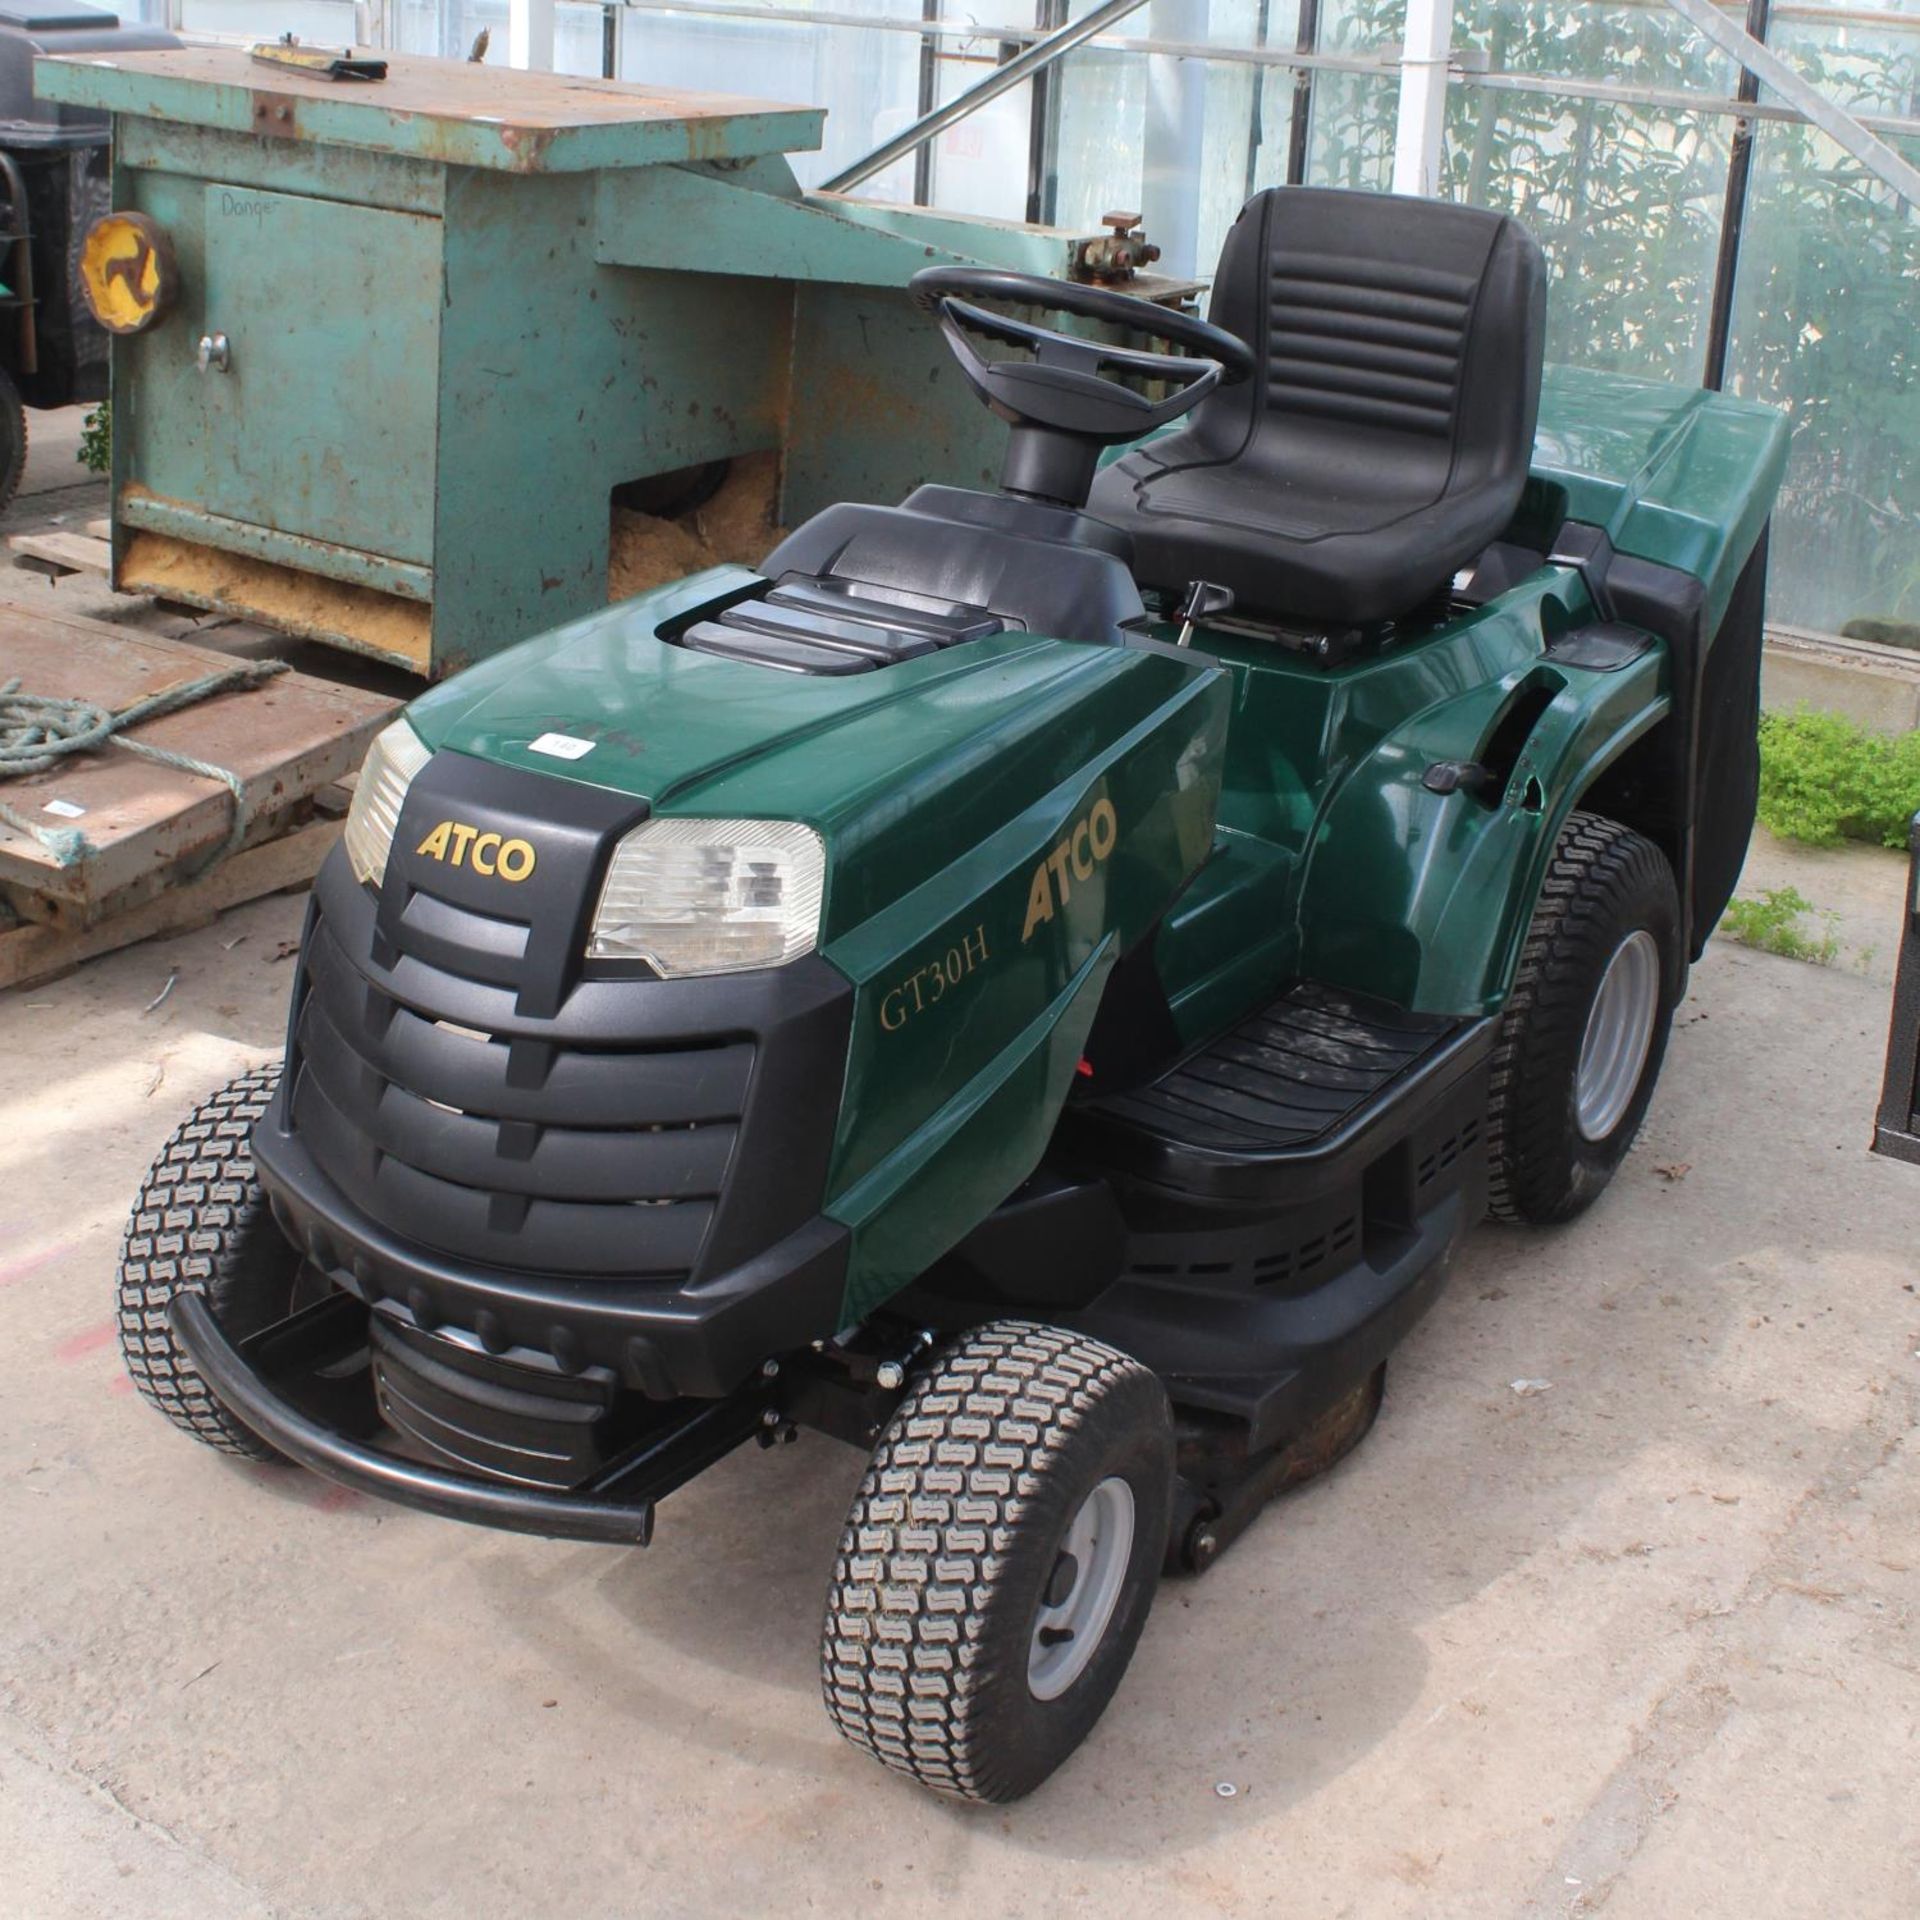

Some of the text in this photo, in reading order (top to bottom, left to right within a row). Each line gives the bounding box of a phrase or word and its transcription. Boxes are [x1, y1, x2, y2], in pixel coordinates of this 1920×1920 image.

[416, 821, 537, 882] ATCO
[1021, 798, 1117, 944] ATCO
[880, 923, 990, 1031] GT30H
